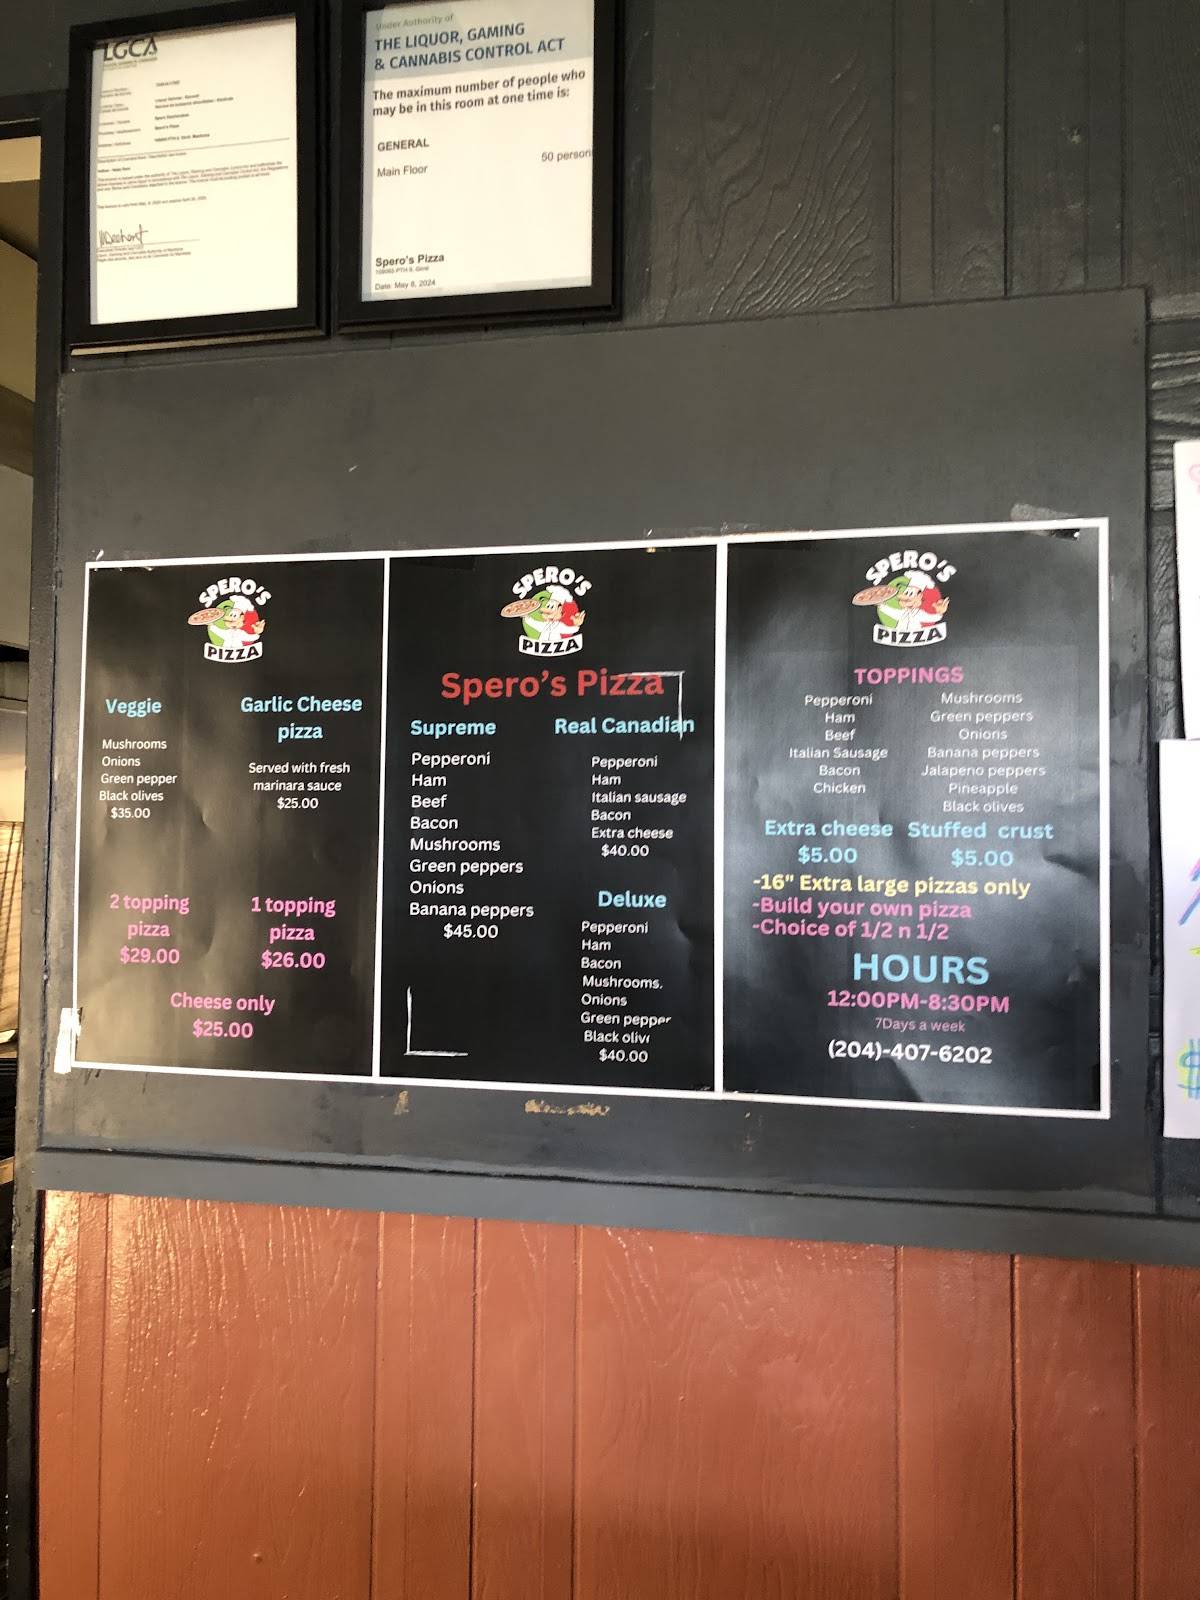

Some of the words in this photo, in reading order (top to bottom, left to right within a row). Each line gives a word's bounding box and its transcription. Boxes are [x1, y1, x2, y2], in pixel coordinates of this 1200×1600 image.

[376, 20, 400, 31] Under
[403, 15, 442, 28] Authority
[444, 14, 454, 22] of
[375, 38, 401, 52] THE
[405, 30, 463, 50] LIQUOR,
[467, 22, 525, 41] GAMING
[374, 58, 385, 70] &
[390, 50, 461, 70] CANNABIS
[465, 42, 533, 62] CONTROL
[537, 38, 565, 53] ACT
[372, 89, 393, 101] The
[396, 84, 452, 99] maximum
[455, 79, 499, 94] number
[502, 77, 515, 89] of
[518, 73, 558, 93] people
[561, 68, 585, 82] who
[372, 103, 396, 118] may
[399, 101, 413, 114] be
[416, 100, 427, 112] in
[430, 97, 451, 111] this
[455, 96, 484, 109] room
[487, 93, 499, 105] at
[502, 92, 524, 104] one
[527, 89, 554, 102] time
[556, 87, 569, 99] is:
[377, 138, 429, 152] GENERAL
[377, 166, 400, 177] Main
[403, 164, 428, 175] Floor
[376, 256, 414, 268] Spero's
[418, 254, 444, 263] Pizza
[865, 550, 957, 585] SPERO'S
[512, 566, 592, 600] SPERO'S
[199, 576, 271, 608] SPERO'S
[877, 627, 943, 644] PIZZA
[207, 646, 260, 660] PIZZA
[522, 639, 579, 654] PIZZA
[854, 666, 964, 685] TOPPINGS
[441, 670, 566, 705] Spero's
[578, 669, 664, 696] Pizza
[240, 696, 293, 713] Garlic
[297, 696, 362, 713] Cheese
[804, 693, 872, 708] Pepperoni
[941, 692, 1022, 704] Mushrooms
[105, 698, 161, 718] Veggie
[554, 718, 596, 734] Real
[601, 716, 695, 734] Canadian
[825, 712, 855, 723] Ham
[930, 711, 971, 722] Green
[975, 711, 1033, 724] peppers
[277, 723, 323, 743] pizza
[411, 720, 496, 739] Supreme
[825, 729, 856, 741] Beef
[958, 729, 1007, 740] Onions
[102, 739, 167, 750] Mushrooms
[411, 752, 491, 768] Pepperoni
[789, 747, 829, 758] Italian
[833, 747, 888, 760] Sausage
[928, 747, 978, 758] Banana
[983, 748, 1040, 760] peppers
[102, 756, 140, 767] Onions
[249, 762, 289, 774] Served
[292, 762, 317, 774] with
[320, 762, 350, 774] fresh
[592, 755, 657, 770] Pepperoni
[819, 765, 860, 776] Bacon
[921, 765, 984, 779] Jalapeno
[988, 766, 1046, 779] peppers
[101, 773, 134, 784] Green
[137, 774, 177, 786] pepper
[253, 780, 305, 791] marinara
[307, 781, 342, 791] sauce
[411, 774, 447, 787] Ham
[592, 774, 621, 785] Ham
[813, 782, 865, 794] Chicken
[948, 783, 1018, 796] Pineapple
[99, 790, 128, 801] Black
[131, 791, 164, 802] olives
[277, 797, 319, 810] $25.00
[411, 794, 447, 808] Beef
[592, 791, 631, 803] Italian
[634, 792, 687, 806] sausage
[111, 806, 150, 819] $35.00
[943, 801, 980, 812] Black
[983, 801, 1024, 813] olives
[410, 816, 458, 829] Bacon
[591, 809, 631, 821] Bacon
[592, 827, 624, 839] Extra
[628, 826, 673, 839] cheese
[765, 820, 816, 837] Extra
[821, 820, 893, 837] cheese
[907, 821, 986, 839] Stuffed
[998, 823, 1054, 839] crust
[410, 838, 500, 851] Mushrooms
[601, 843, 649, 857] $40.00
[798, 845, 857, 865] $5.00
[951, 849, 1014, 868] $5.00
[410, 859, 456, 872] Green
[460, 861, 523, 876] peppers
[410, 880, 464, 894] Onions
[753, 874, 794, 890] -16"
[800, 875, 852, 891] Extra
[857, 875, 908, 897] large
[914, 877, 977, 897] pizzas
[983, 878, 1031, 899] only
[110, 894, 120, 909] 2
[123, 895, 190, 915] topping
[598, 890, 667, 908] Deluxe
[251, 897, 261, 912] 1
[265, 897, 336, 917] topping
[409, 902, 466, 916] Banana
[471, 905, 534, 920] peppers
[752, 897, 812, 914] -Build
[817, 902, 864, 919] your
[870, 902, 913, 917] own
[919, 901, 973, 920] pizza
[128, 921, 170, 939] pizza
[269, 924, 315, 944] pizza
[444, 923, 498, 939] $45.00
[581, 920, 648, 935] Pepperoni
[752, 919, 829, 936] -Choice
[835, 921, 856, 936] of
[861, 922, 892, 939] 1/2
[898, 926, 910, 938] n
[916, 923, 949, 941] 1/2
[582, 939, 611, 951] Ham
[120, 946, 180, 964] $29.00
[261, 950, 326, 970] $26.00
[581, 957, 621, 969] Bacon
[853, 953, 989, 985] HOURS
[170, 992, 232, 1010] Cheese
[236, 995, 275, 1015] only
[581, 993, 627, 1006] Onions
[827, 991, 1009, 1013] 12:00PM-8:30PM
[581, 1011, 620, 1025] Green
[876, 1018, 915, 1033] 7Days
[919, 1022, 927, 1030] a
[931, 1019, 965, 1033] week
[193, 1019, 253, 1038] $25.00
[584, 1030, 619, 1042] Black
[600, 1048, 648, 1062] $40.00
[828, 1040, 992, 1064] (204)-407-6202
